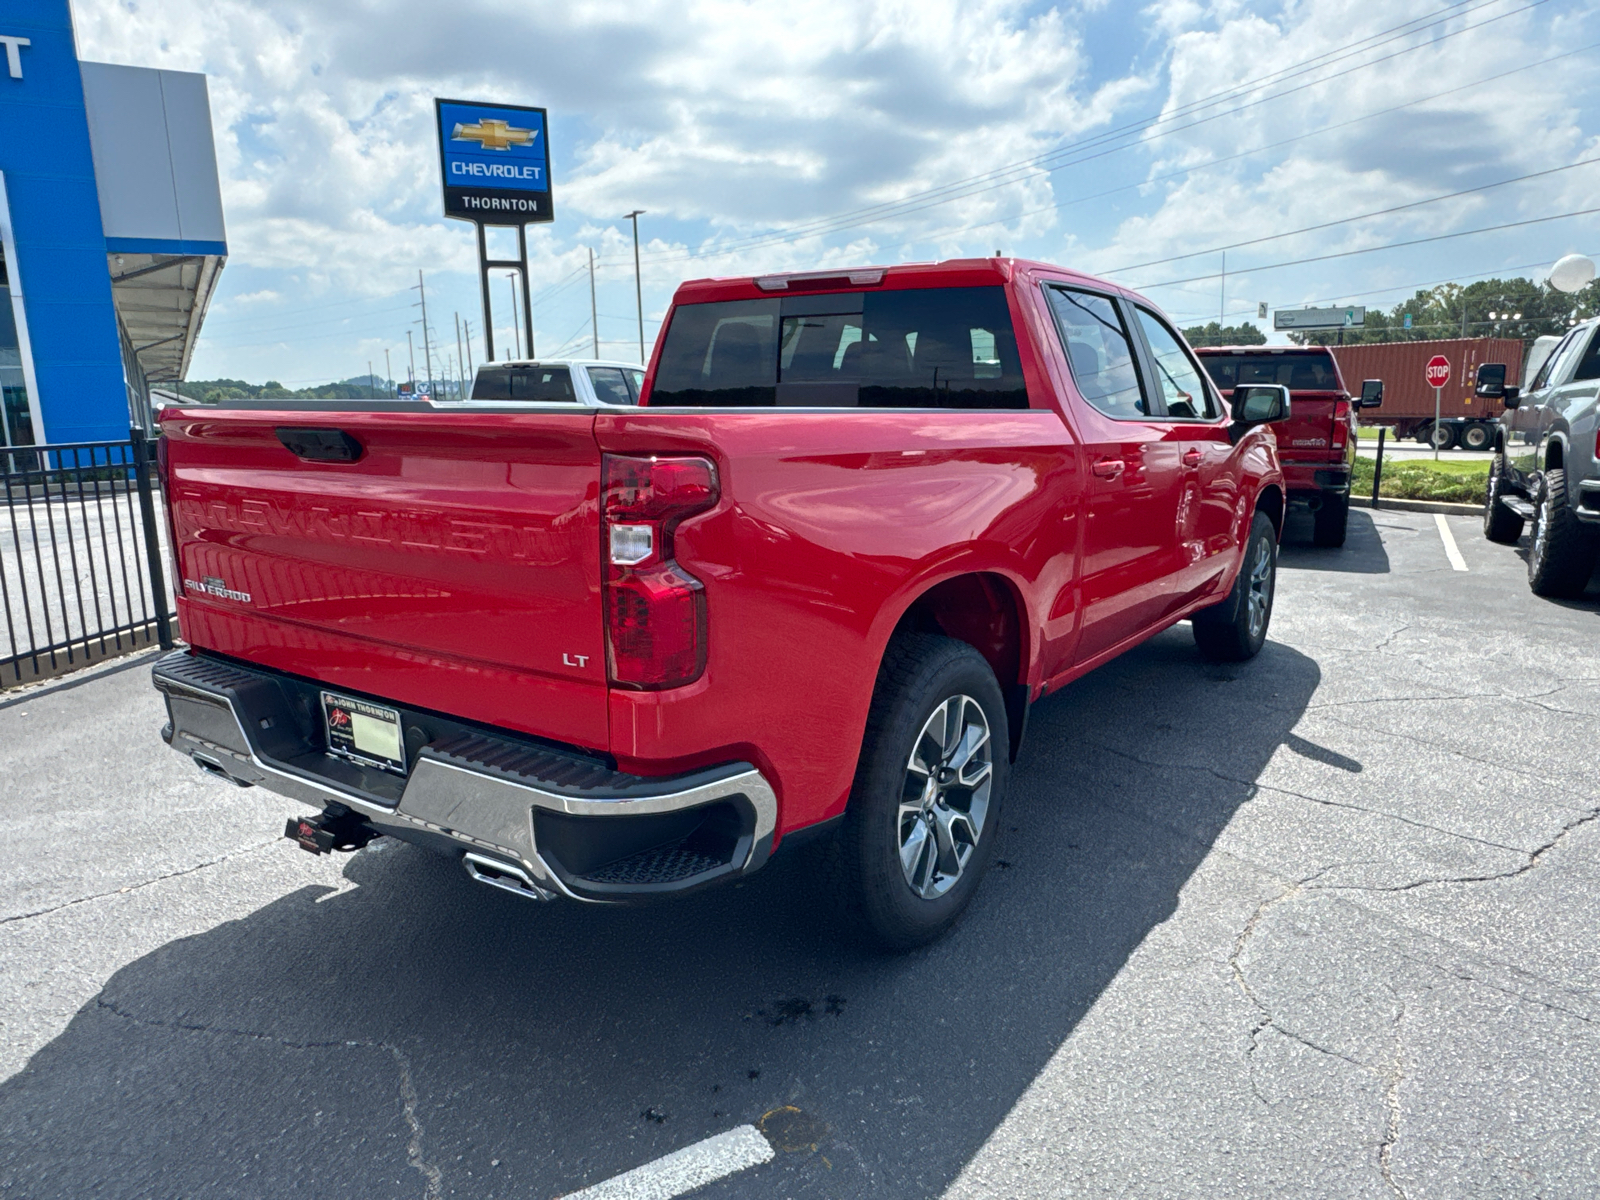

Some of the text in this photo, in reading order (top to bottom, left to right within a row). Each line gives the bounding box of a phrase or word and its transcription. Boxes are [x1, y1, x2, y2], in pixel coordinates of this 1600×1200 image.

[451, 161, 541, 179] CHEVROLET
[462, 196, 538, 211] THORNTON
[1427, 365, 1449, 379] STOP
[184, 579, 252, 603] SILVERADO
[562, 652, 590, 668] LT
[338, 699, 356, 709] JOHN
